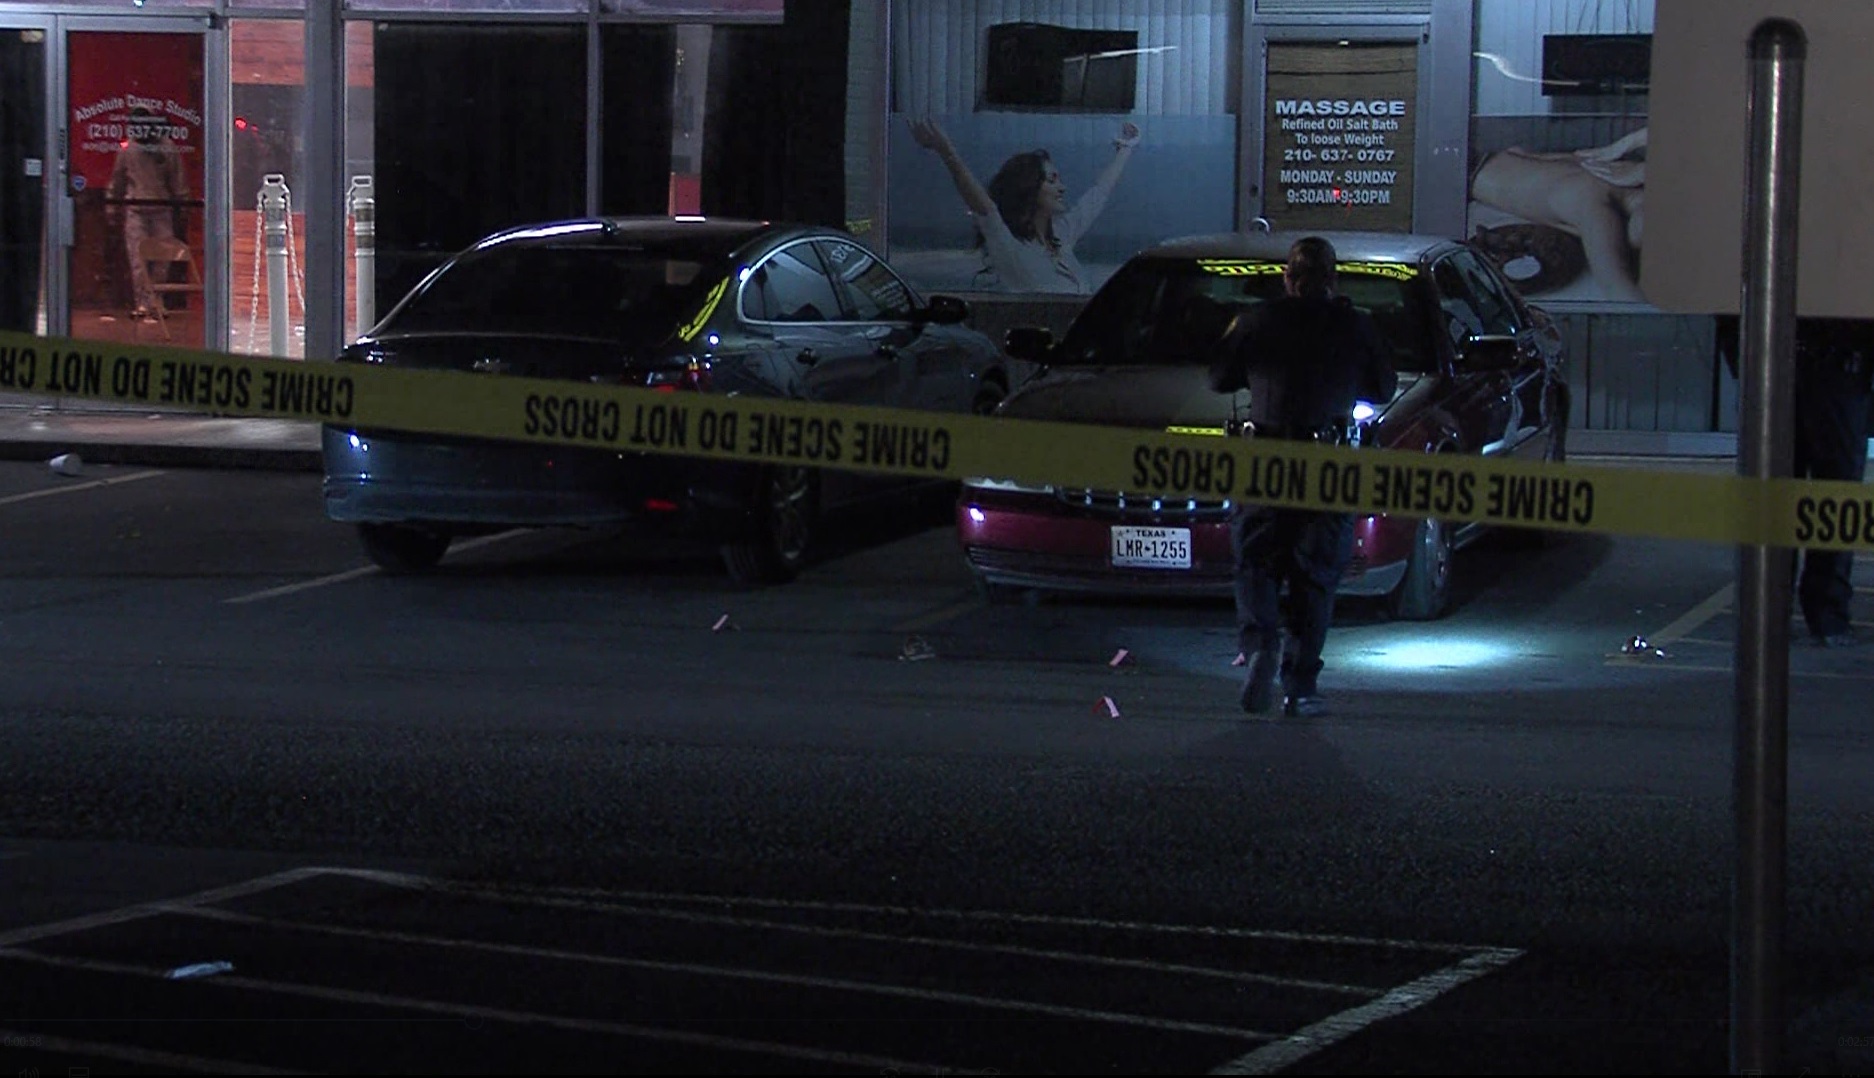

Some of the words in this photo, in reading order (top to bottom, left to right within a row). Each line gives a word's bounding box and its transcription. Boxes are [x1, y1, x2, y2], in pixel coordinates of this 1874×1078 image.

[74, 97, 125, 123] Absolute
[165, 99, 202, 126] Studio
[1275, 100, 1406, 116] MASSAGE
[1282, 118, 1325, 131] Refined
[1327, 118, 1344, 131] Oil
[1346, 118, 1369, 131] Salt
[1372, 118, 1399, 131] Bath
[88, 124, 123, 139] (210)
[126, 124, 190, 140] 637-7700
[1295, 133, 1308, 145] To
[1311, 133, 1341, 145] loose
[1344, 133, 1385, 147] Weight
[1280, 170, 1335, 184] MONDAY
[1344, 170, 1398, 184] SUNDAY
[1284, 149, 1317, 162] 210-
[1357, 149, 1396, 162] 0767
[46, 348, 102, 396] NOT
[113, 352, 149, 399] DO
[160, 362, 252, 408] SCENE
[262, 371, 356, 416] CRIME
[524, 395, 620, 442] CROSS
[629, 405, 688, 446] NOT
[700, 410, 738, 451] DO
[749, 414, 842, 460] SCENE
[853, 423, 950, 470] CRIME
[1132, 445, 1235, 496] CROSS
[1246, 456, 1309, 502] NOT
[1319, 461, 1361, 505] DO
[1373, 465, 1475, 513] SCENE
[1488, 475, 1594, 524] CRIME
[1136, 529, 1166, 538] TEXAS
